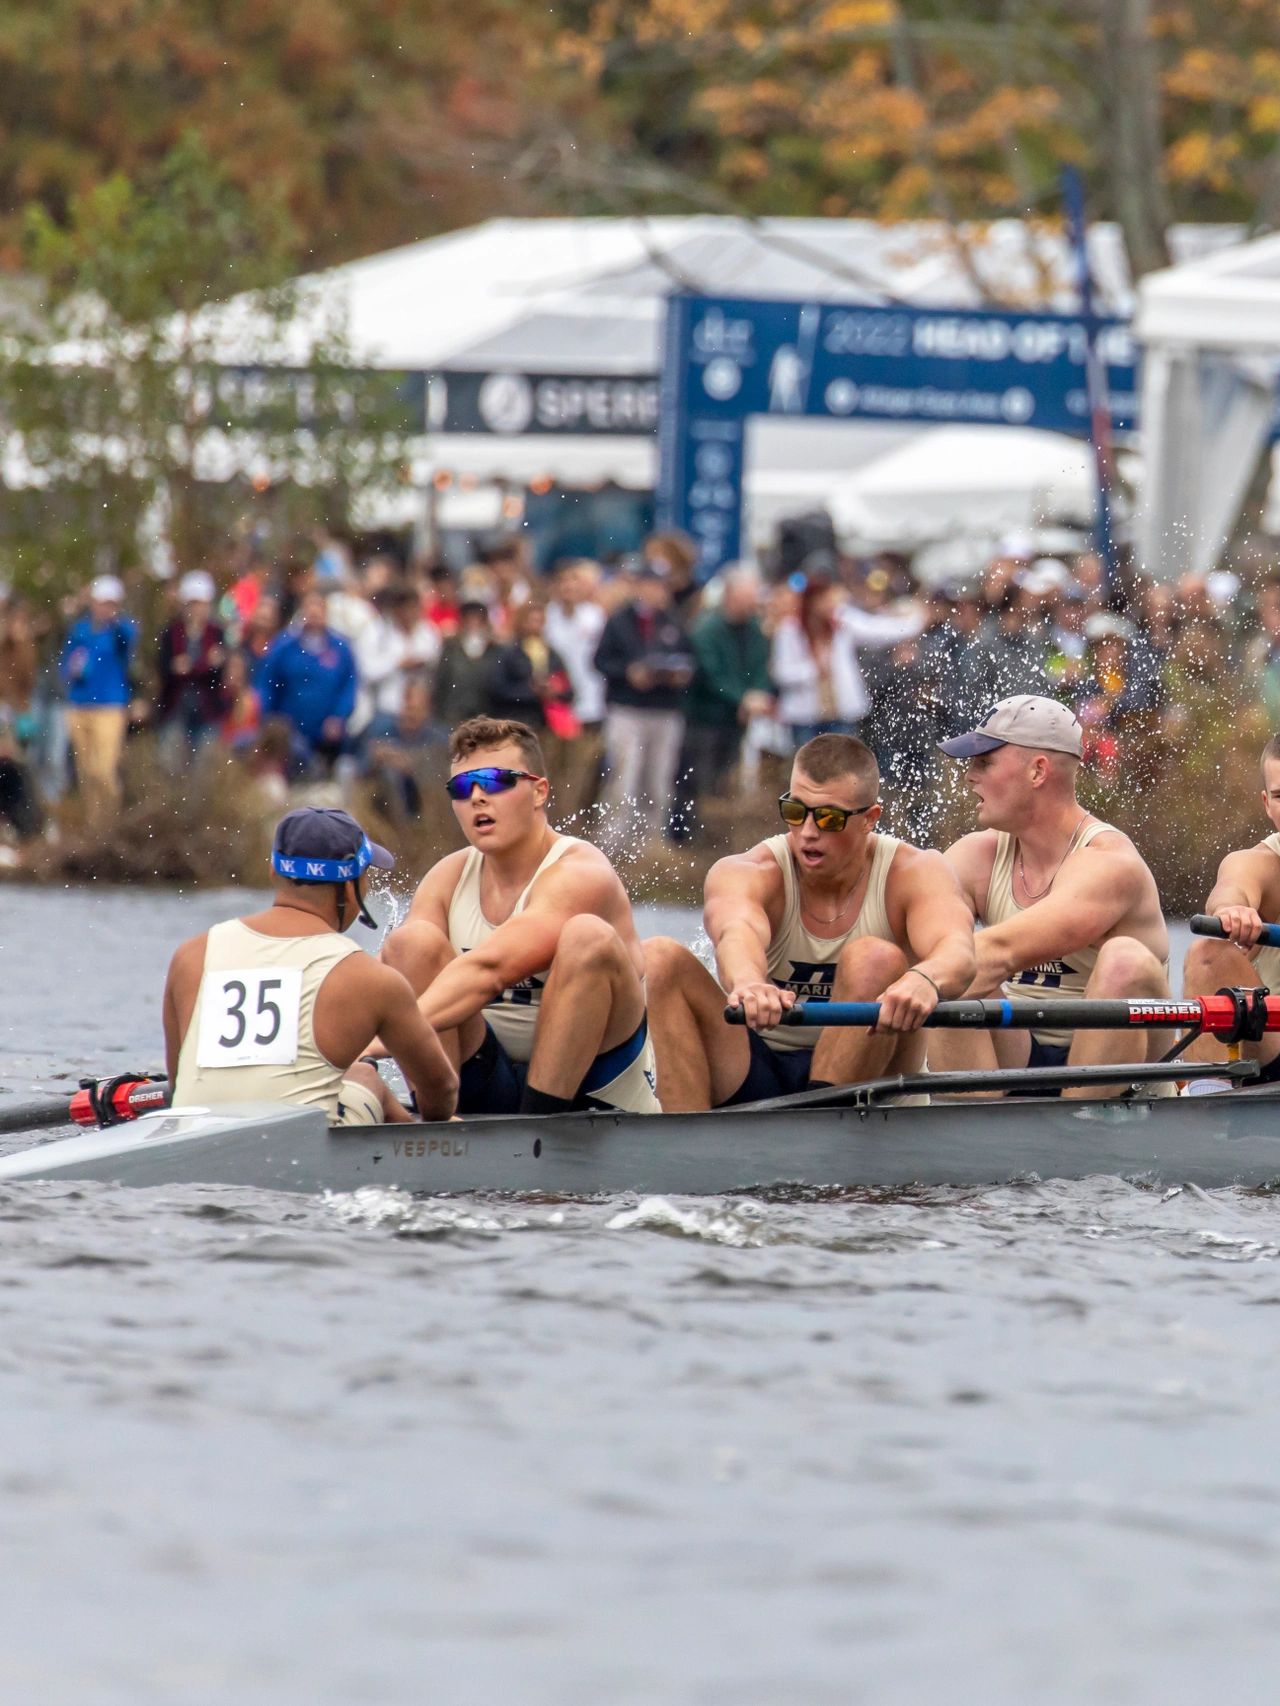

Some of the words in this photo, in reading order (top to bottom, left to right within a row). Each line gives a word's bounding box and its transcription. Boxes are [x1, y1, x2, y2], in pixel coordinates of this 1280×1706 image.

[913, 316, 1012, 361] HEAD
[1012, 320, 1064, 363] OF
[279, 859, 296, 873] NK
[306, 862, 326, 876] NK
[337, 864, 353, 878] NK
[218, 979, 282, 1049] 35
[1128, 1005, 1202, 1016] DREHER
[128, 1091, 164, 1104] DREHER
[392, 1139, 470, 1157] VESPOLI
